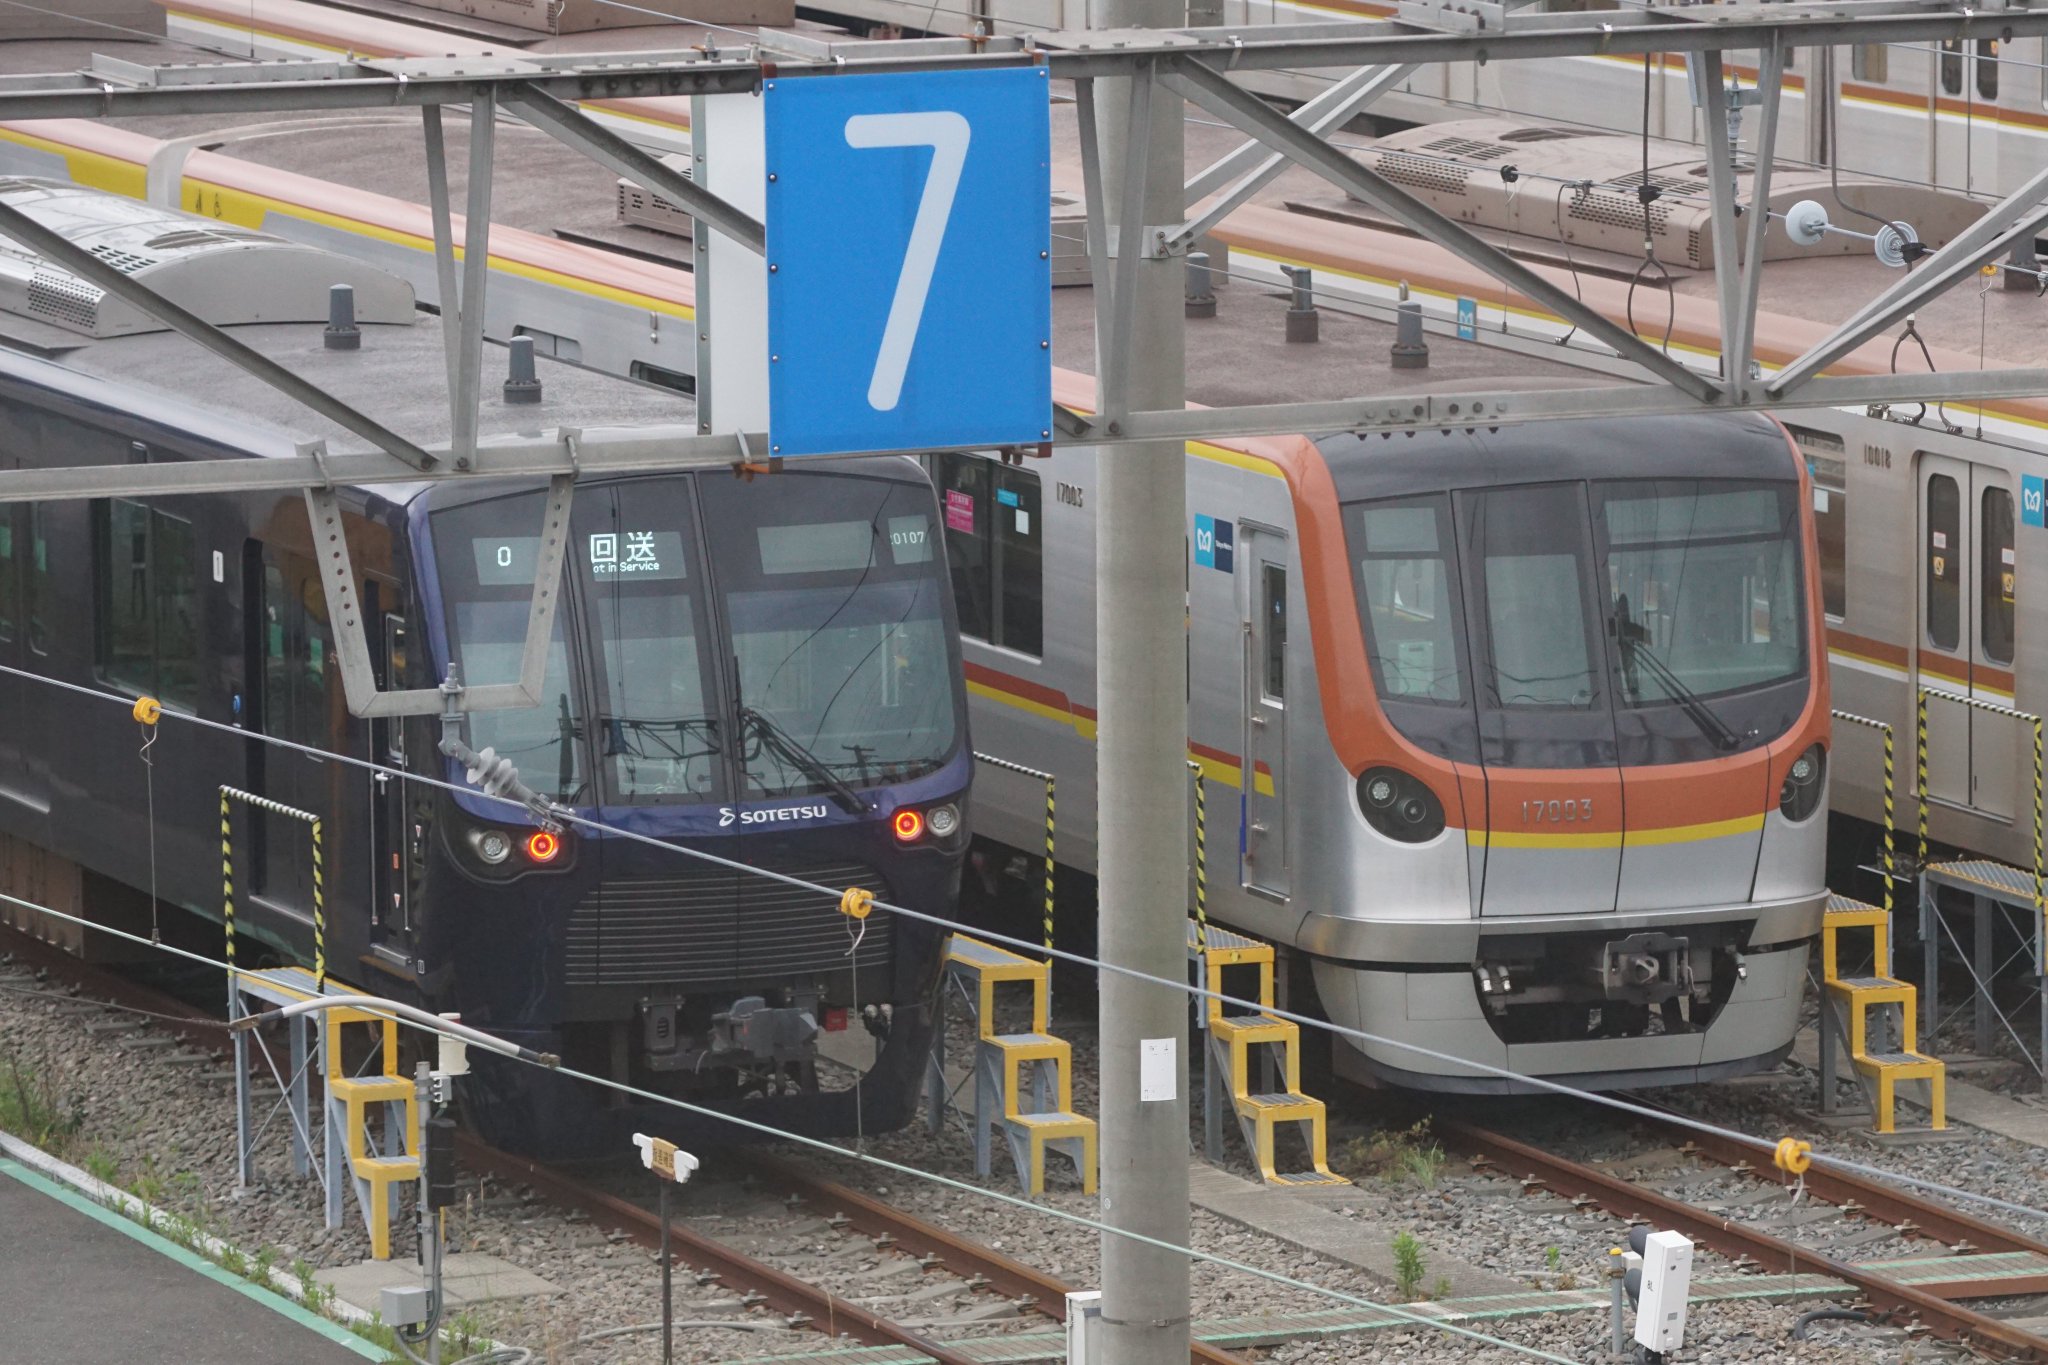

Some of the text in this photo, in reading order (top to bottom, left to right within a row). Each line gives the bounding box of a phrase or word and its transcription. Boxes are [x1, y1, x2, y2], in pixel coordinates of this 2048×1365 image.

[844, 111, 971, 411] 7
[1056, 481, 1083, 508] 17003
[497, 546, 512, 567] 0
[590, 531, 656, 563] 回送
[608, 562, 617, 573] in
[619, 561, 660, 572] Service
[740, 805, 827, 824] SOTETSU
[1522, 798, 1593, 823] 17003
